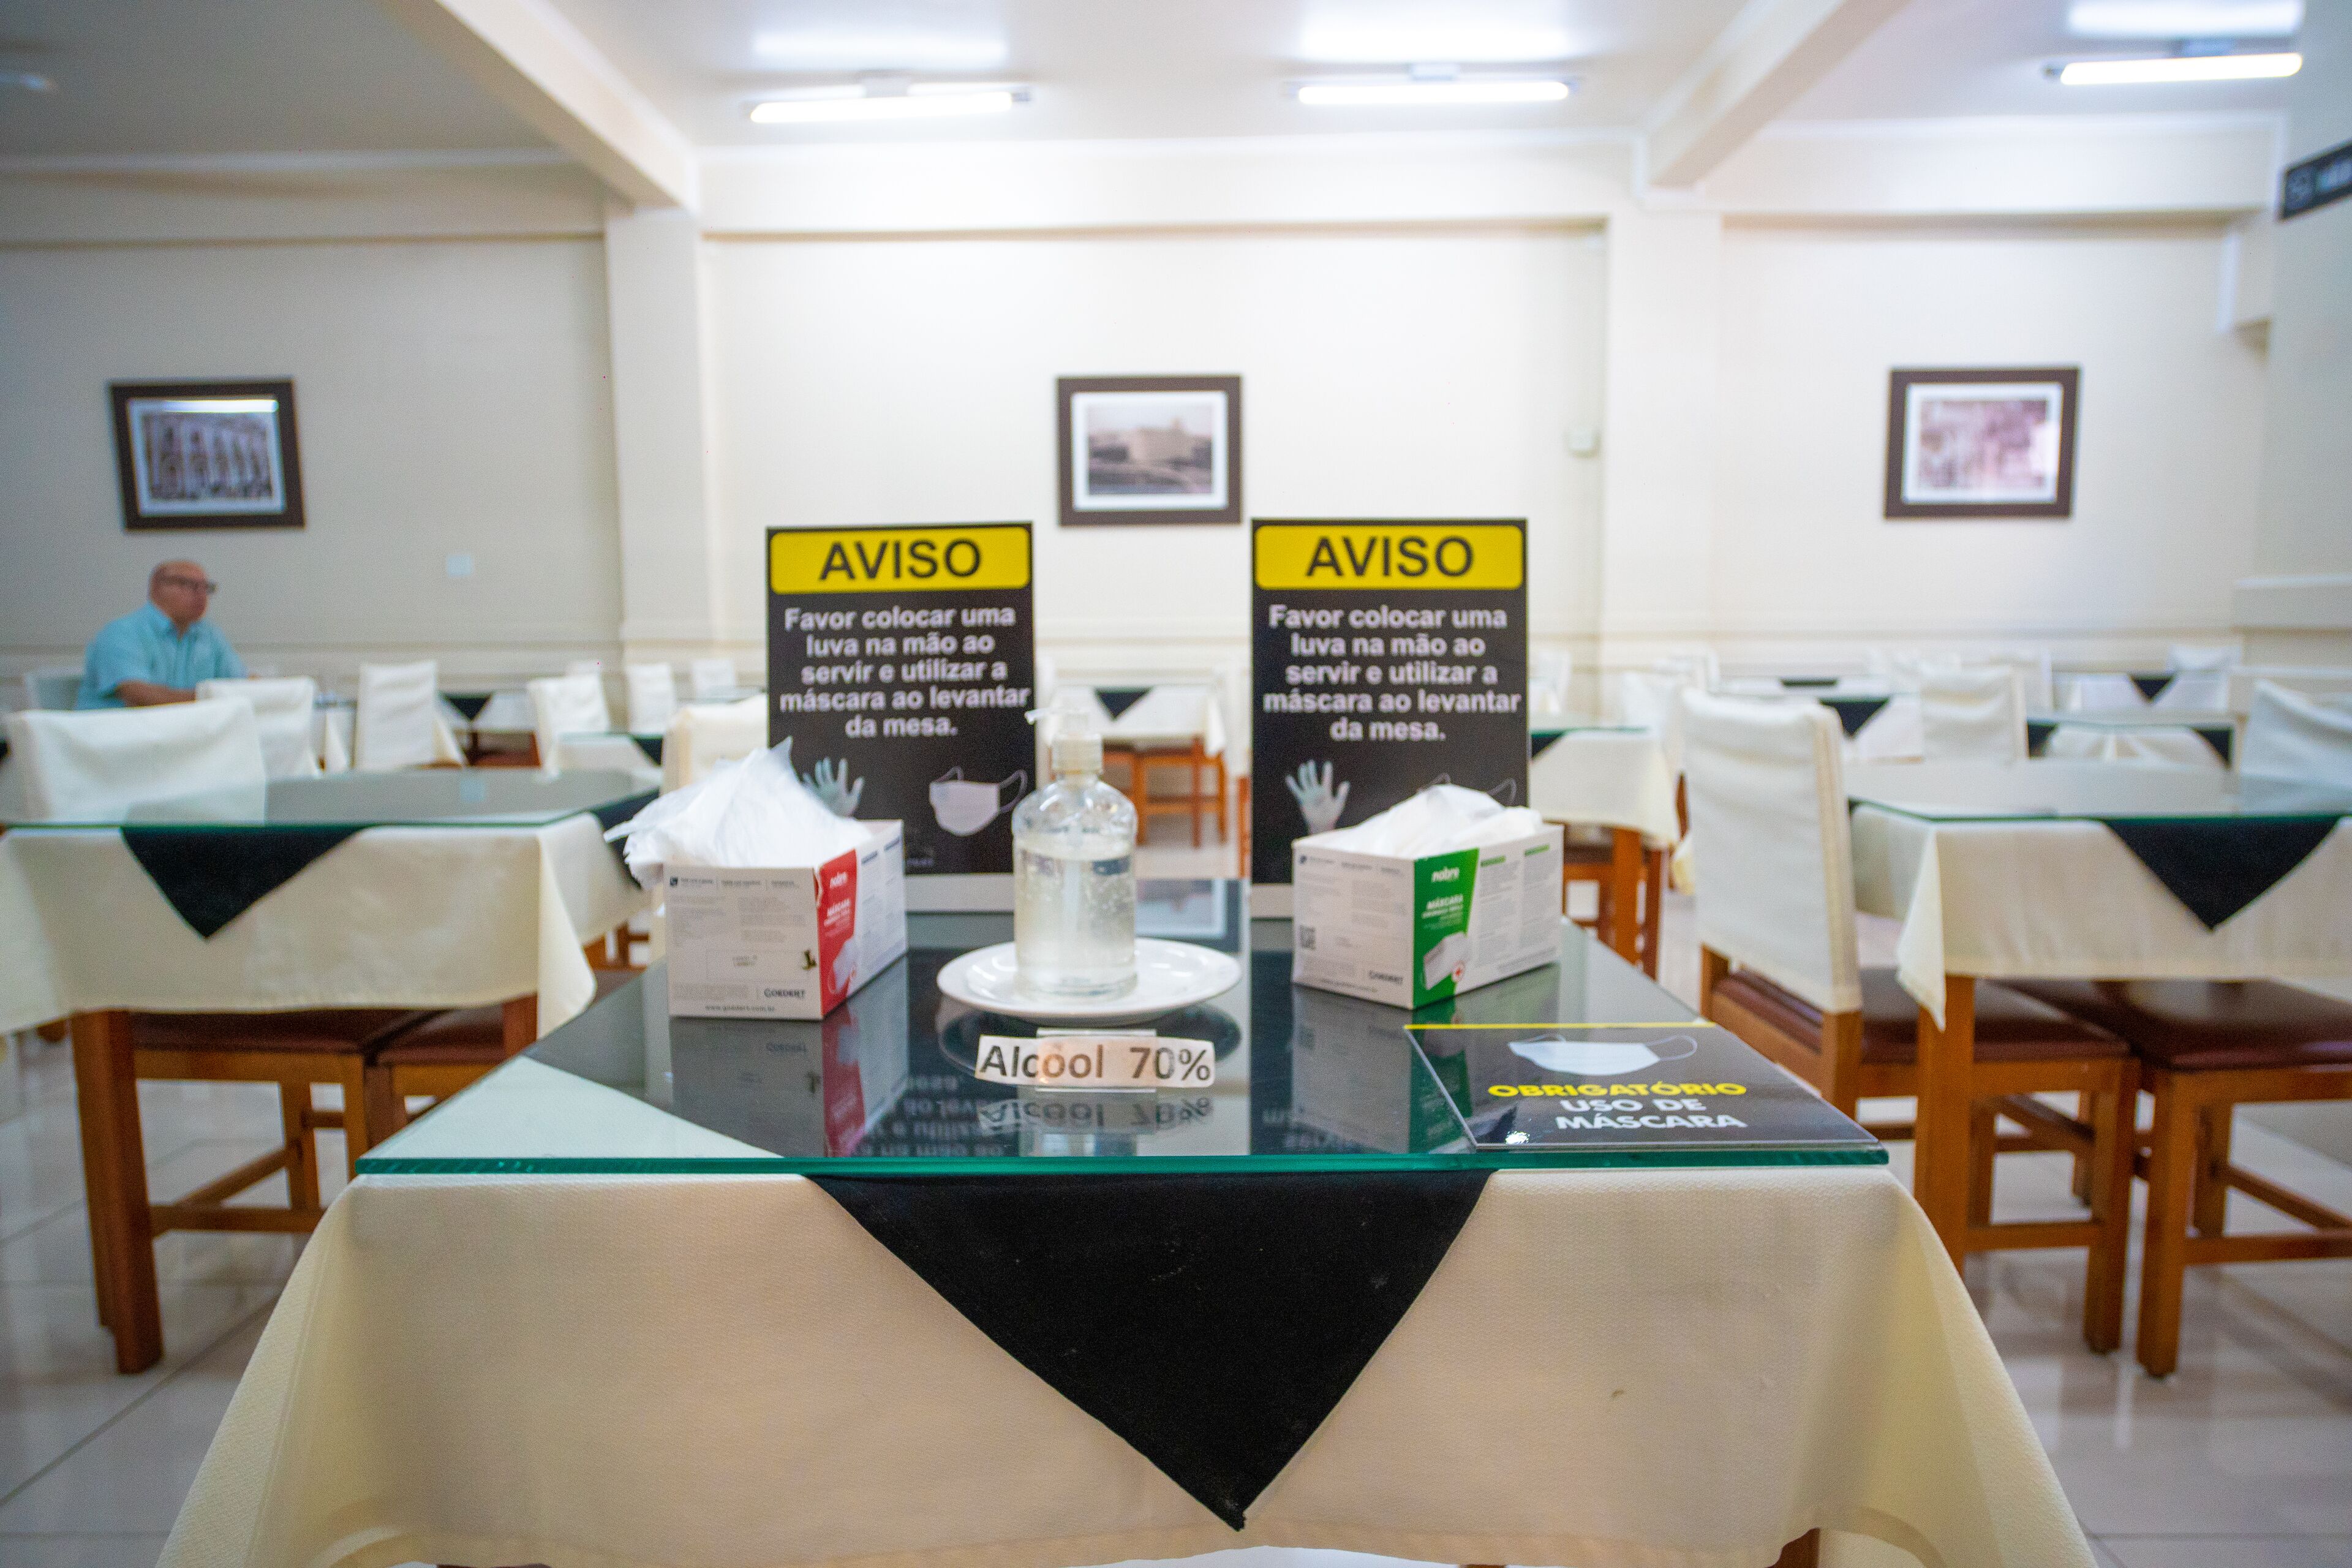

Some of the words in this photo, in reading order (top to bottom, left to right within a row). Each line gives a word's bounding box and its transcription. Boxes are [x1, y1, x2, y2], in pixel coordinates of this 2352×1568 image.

[820, 539, 981, 581] AVISO
[1306, 536, 1474, 577] AVISO
[785, 608, 856, 630] Favor
[862, 607, 956, 628] colocar
[962, 607, 1016, 626] uma
[1268, 605, 1343, 628] Favor
[1349, 606, 1445, 628] colocar
[1452, 609, 1507, 628] uma
[807, 636, 856, 657] luva
[866, 636, 897, 655] na
[902, 634, 956, 655] mão
[963, 633, 996, 654] ao
[1291, 634, 1343, 656] luva
[1351, 637, 1384, 656] na
[1391, 635, 1447, 657] mão
[1454, 638, 1487, 657] ao
[801, 661, 872, 684] servir
[879, 665, 895, 682] e
[901, 660, 986, 682] utilizar
[992, 663, 1008, 680] a
[1286, 662, 1359, 685] servir
[1365, 666, 1382, 685] e
[1389, 662, 1476, 685] utilizar
[1482, 666, 1498, 685] a
[780, 690, 883, 711] máscara
[892, 692, 924, 709] ao
[930, 688, 1030, 709] levantar
[1264, 690, 1372, 712] máscara
[1379, 693, 1412, 712] ao
[1418, 690, 1522, 713] levantar
[846, 716, 878, 737] da
[883, 718, 957, 737] mesa.
[1330, 718, 1363, 741] da
[1369, 722, 1446, 741] mesa.
[979, 1044, 1103, 1079] Alcool
[1129, 1047, 1212, 1082] 70%
[1488, 1080, 1747, 1097] OBRIGATÓRIO
[1559, 1099, 1643, 1112] USO
[1654, 1098, 1707, 1112] DE
[1555, 1112, 1748, 1129] MÁSCARA
